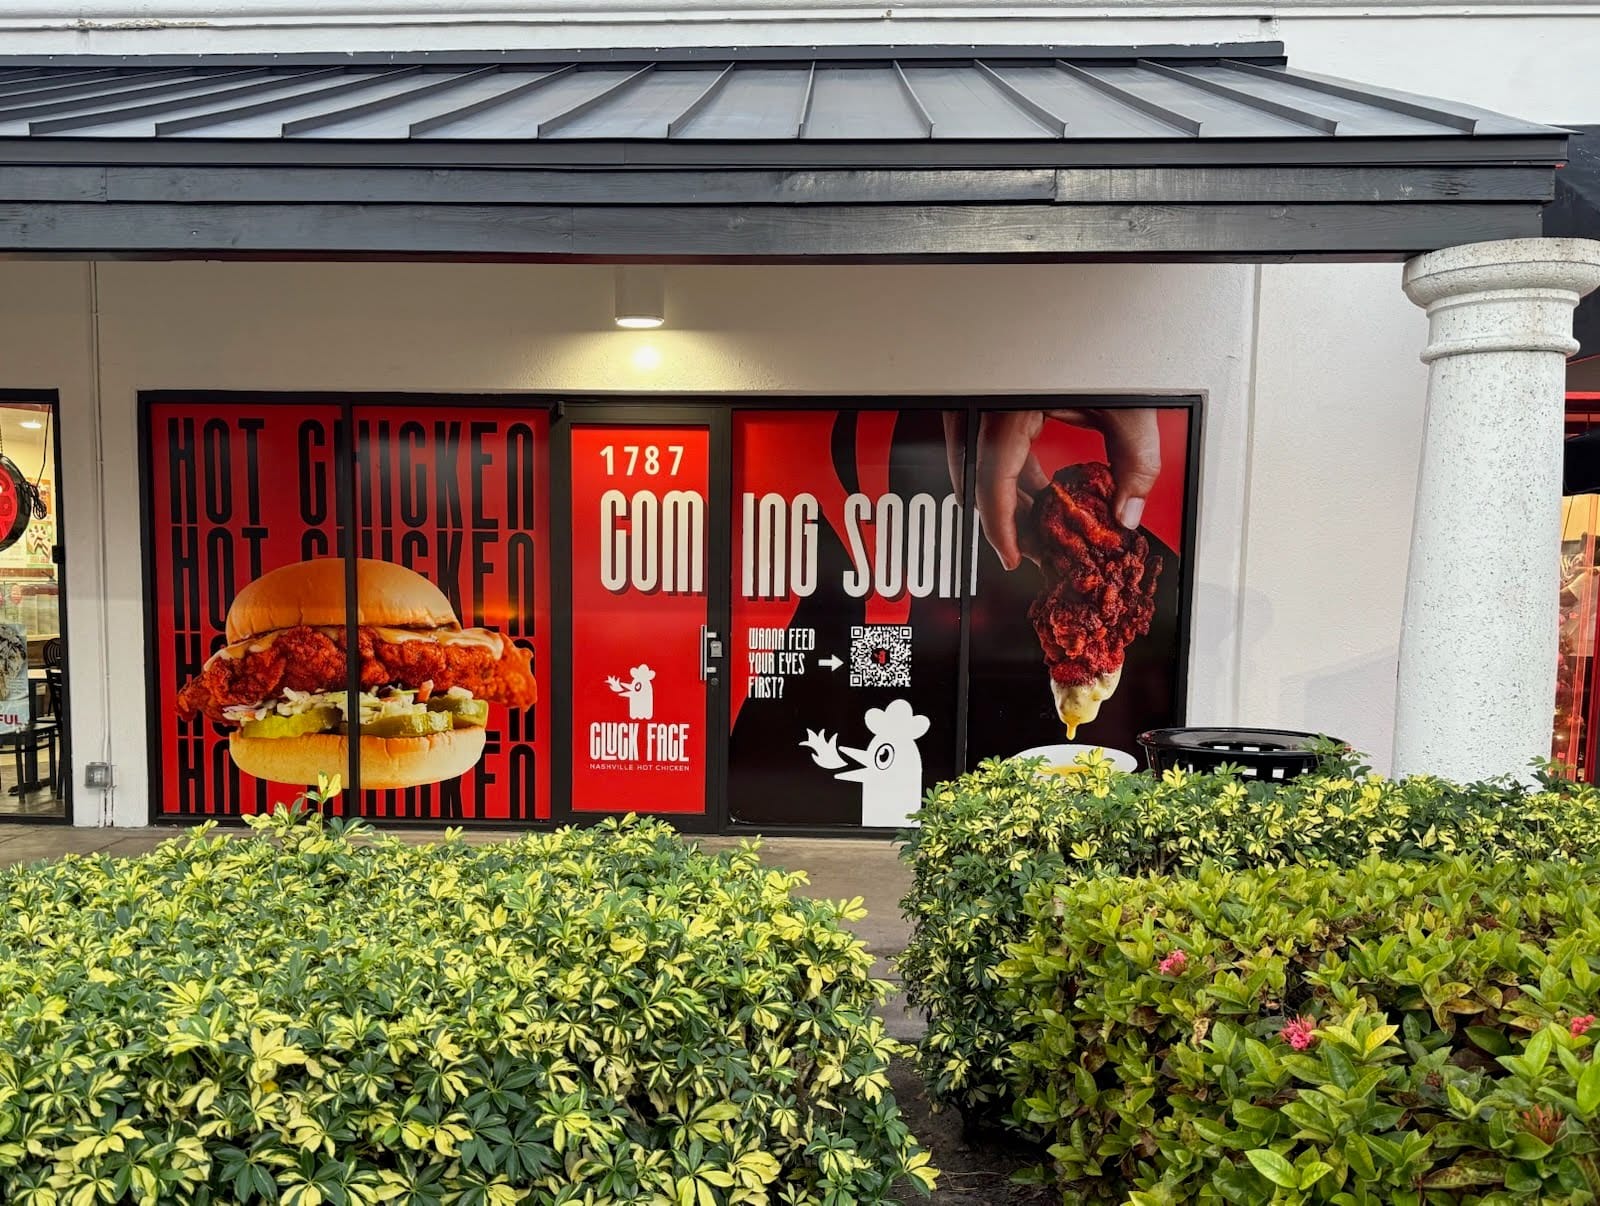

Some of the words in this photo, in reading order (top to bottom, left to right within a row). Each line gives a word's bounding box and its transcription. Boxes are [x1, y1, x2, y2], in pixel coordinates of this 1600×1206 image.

[168, 417, 265, 526] HOT
[298, 418, 535, 530] CHICKEN
[600, 445, 684, 476] 1787
[843, 492, 980, 598] SOON
[748, 627, 785, 651] WANNA
[788, 628, 816, 651] FEED
[748, 652, 775, 675] YOUR
[778, 652, 806, 675] EYES
[747, 676, 785, 699] FIRST?
[589, 722, 640, 761] CLUCK
[646, 723, 690, 762] FACE
[589, 763, 634, 771] NASHVILLE
[655, 764, 690, 772] CHICKEN
